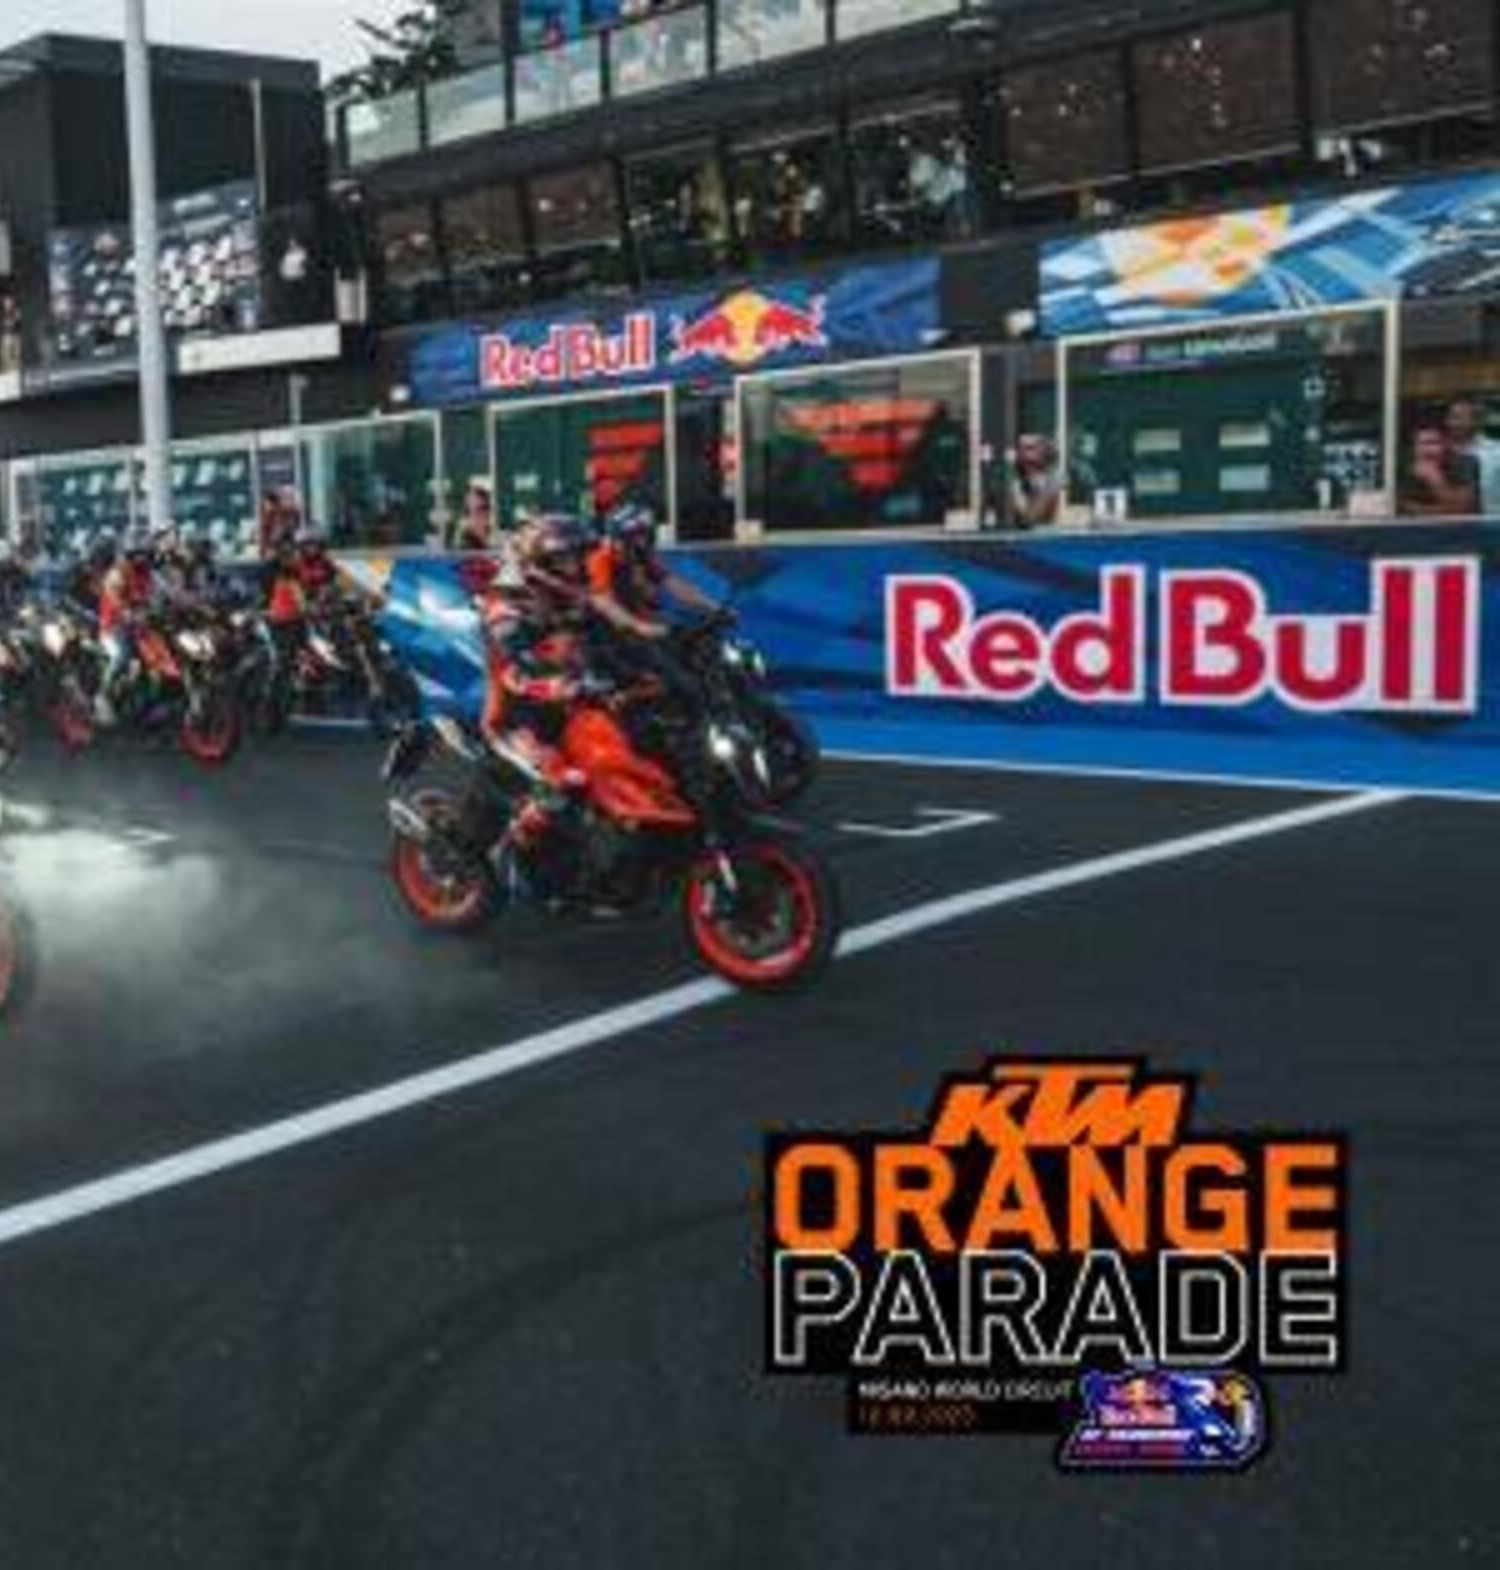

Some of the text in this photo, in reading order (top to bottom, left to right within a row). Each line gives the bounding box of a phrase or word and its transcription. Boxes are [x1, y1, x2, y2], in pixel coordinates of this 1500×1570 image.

[481, 312, 655, 387] Red Bull
[884, 555, 1479, 713] Red Bull
